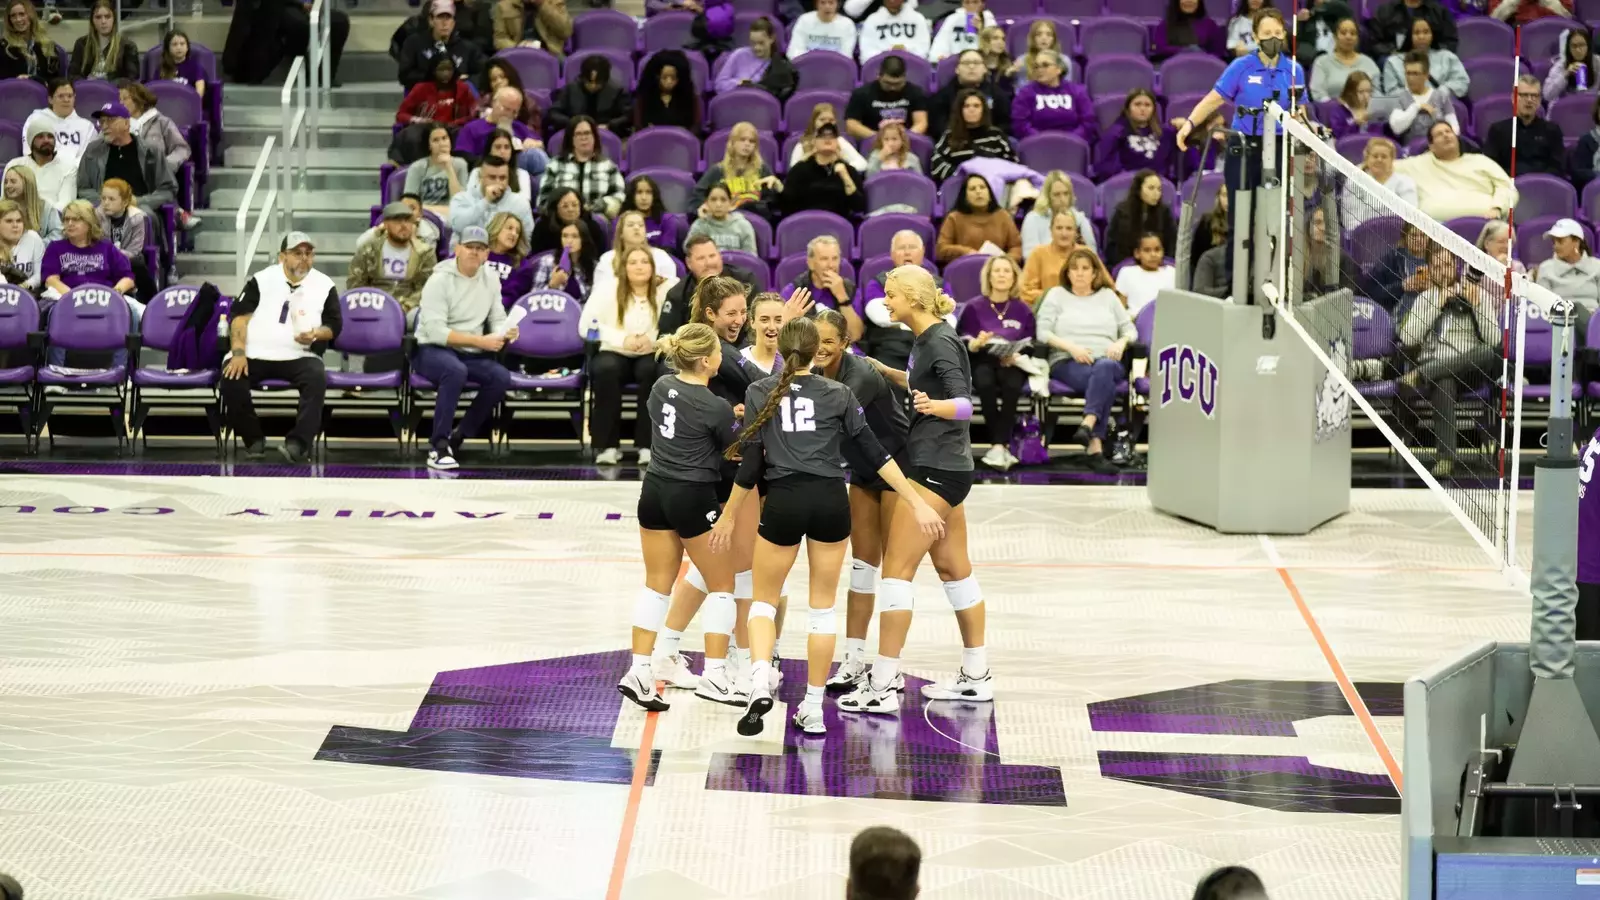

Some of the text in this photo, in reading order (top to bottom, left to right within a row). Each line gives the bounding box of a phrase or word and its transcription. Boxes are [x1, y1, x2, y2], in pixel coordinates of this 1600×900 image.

[876, 23, 916, 40] TCU
[1035, 94, 1072, 110] TCU
[72, 289, 112, 307] TCU
[346, 292, 386, 310] TCU
[527, 294, 568, 313] TCU
[1158, 344, 1218, 420] TCU
[659, 403, 676, 440] 3
[779, 396, 816, 432] 12
